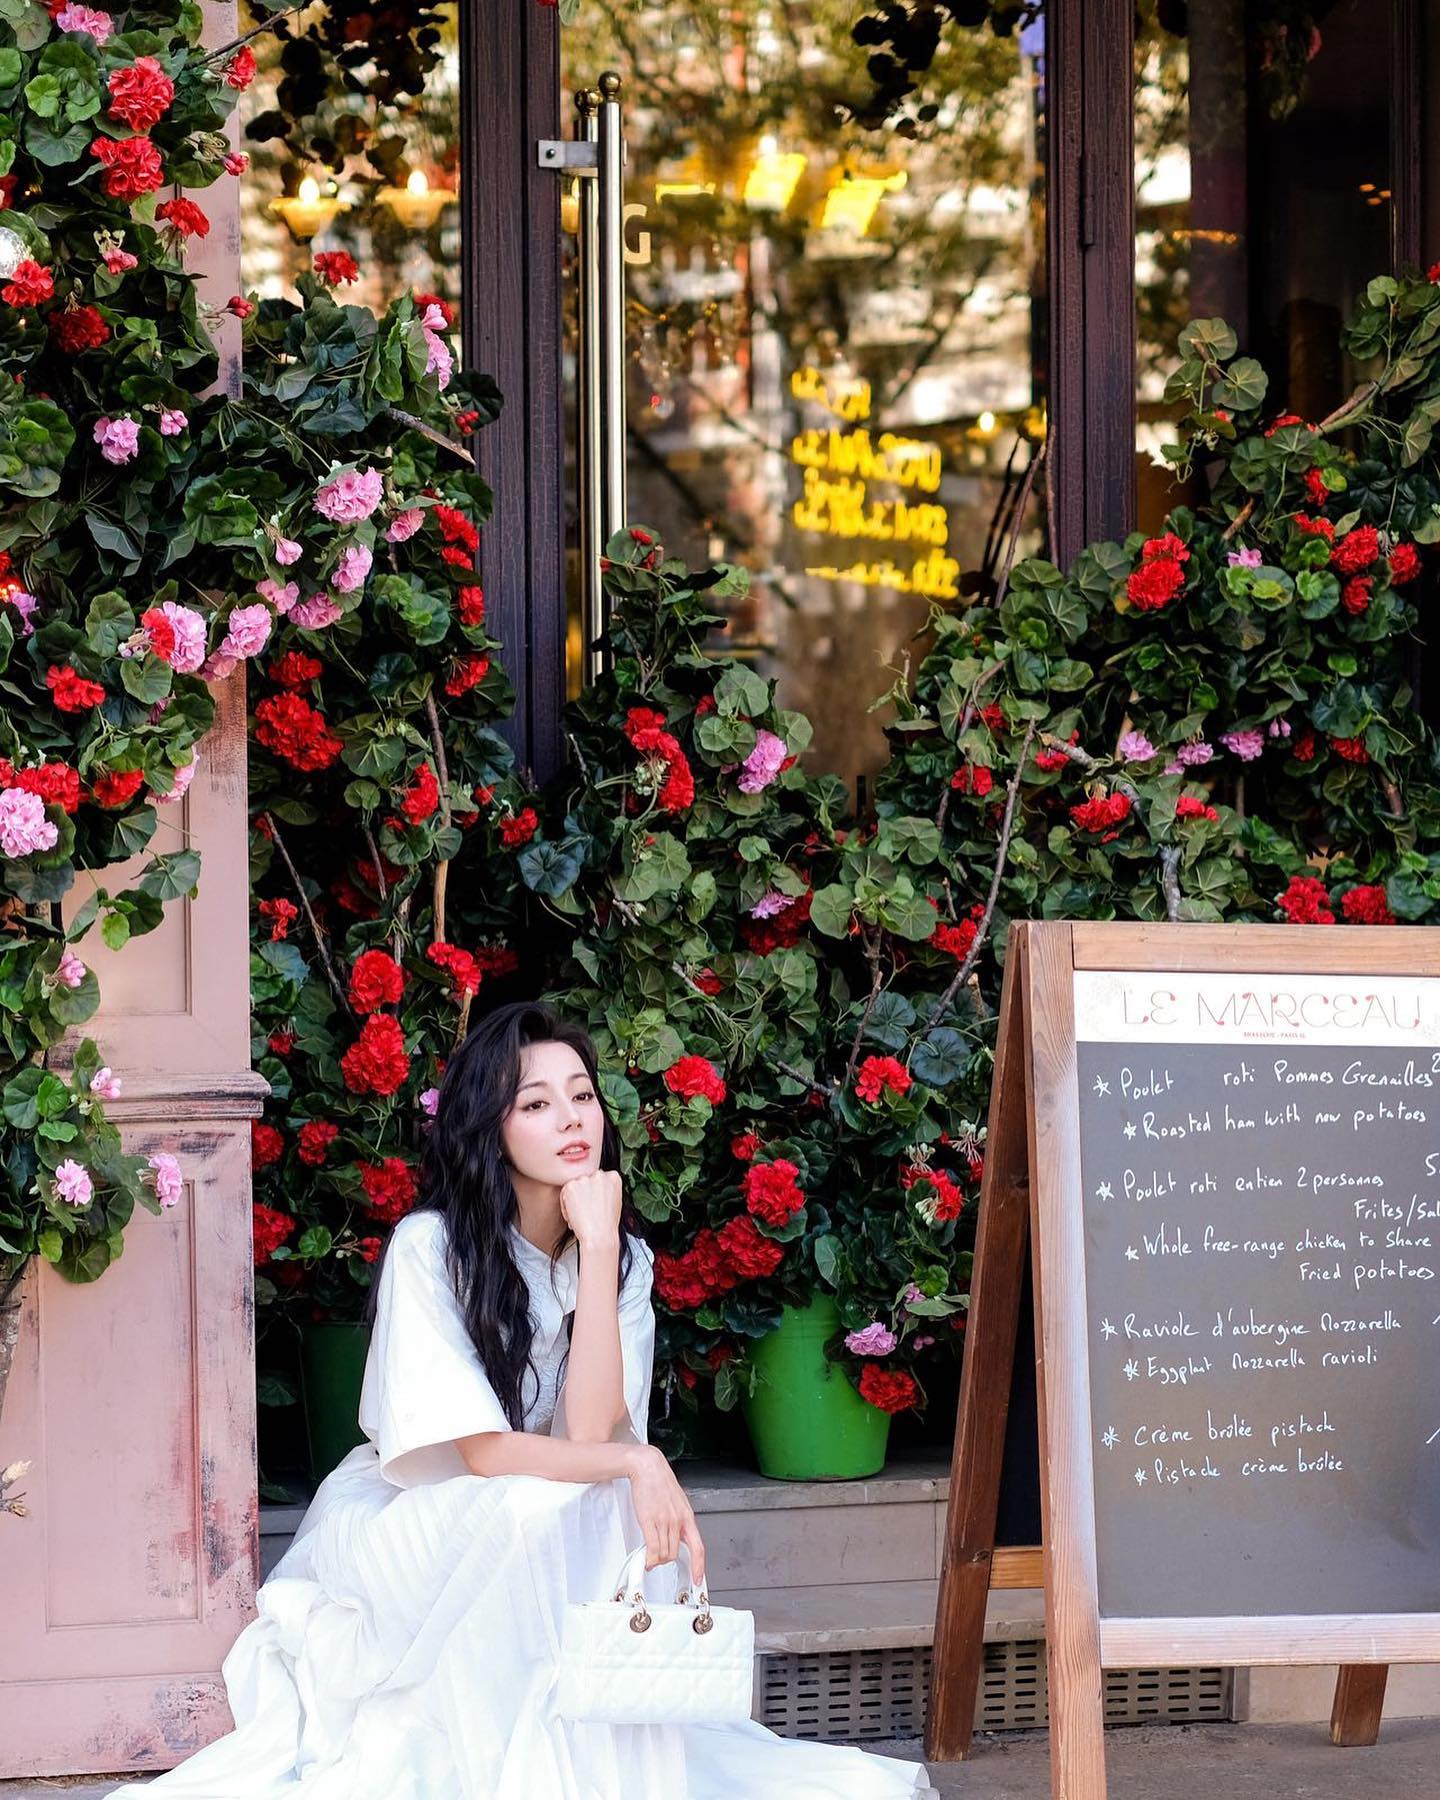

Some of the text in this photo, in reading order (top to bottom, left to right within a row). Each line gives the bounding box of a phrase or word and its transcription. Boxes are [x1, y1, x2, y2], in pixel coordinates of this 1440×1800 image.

[1123, 990, 1422, 1029] LE MARCEAU
[1121, 1068, 1173, 1099] Poulet
[1274, 1060, 1333, 1084] Pommes
[1143, 1112, 1210, 1140] Roasted
[1265, 1103, 1300, 1125] with
[1354, 1101, 1426, 1130] potatoes
[1124, 1169, 1176, 1201] Poulet
[1190, 1173, 1216, 1193] roti
[1297, 1167, 1307, 1187] 2
[1314, 1173, 1383, 1194] personnes
[1143, 1223, 1431, 1259] Whole free-range chicken to Share
[1300, 1259, 1435, 1290] Fried potatoes
[1125, 1312, 1199, 1338] Raviole
[1213, 1308, 1310, 1345] d'aubergine
[1148, 1357, 1212, 1384] Eggplant
[1323, 1345, 1377, 1366] ravioli
[1135, 1425, 1193, 1445] Crème
[1208, 1410, 1252, 1439] brûlée
[1242, 1458, 1287, 1475] crème
[1299, 1448, 1342, 1472] brûlée
